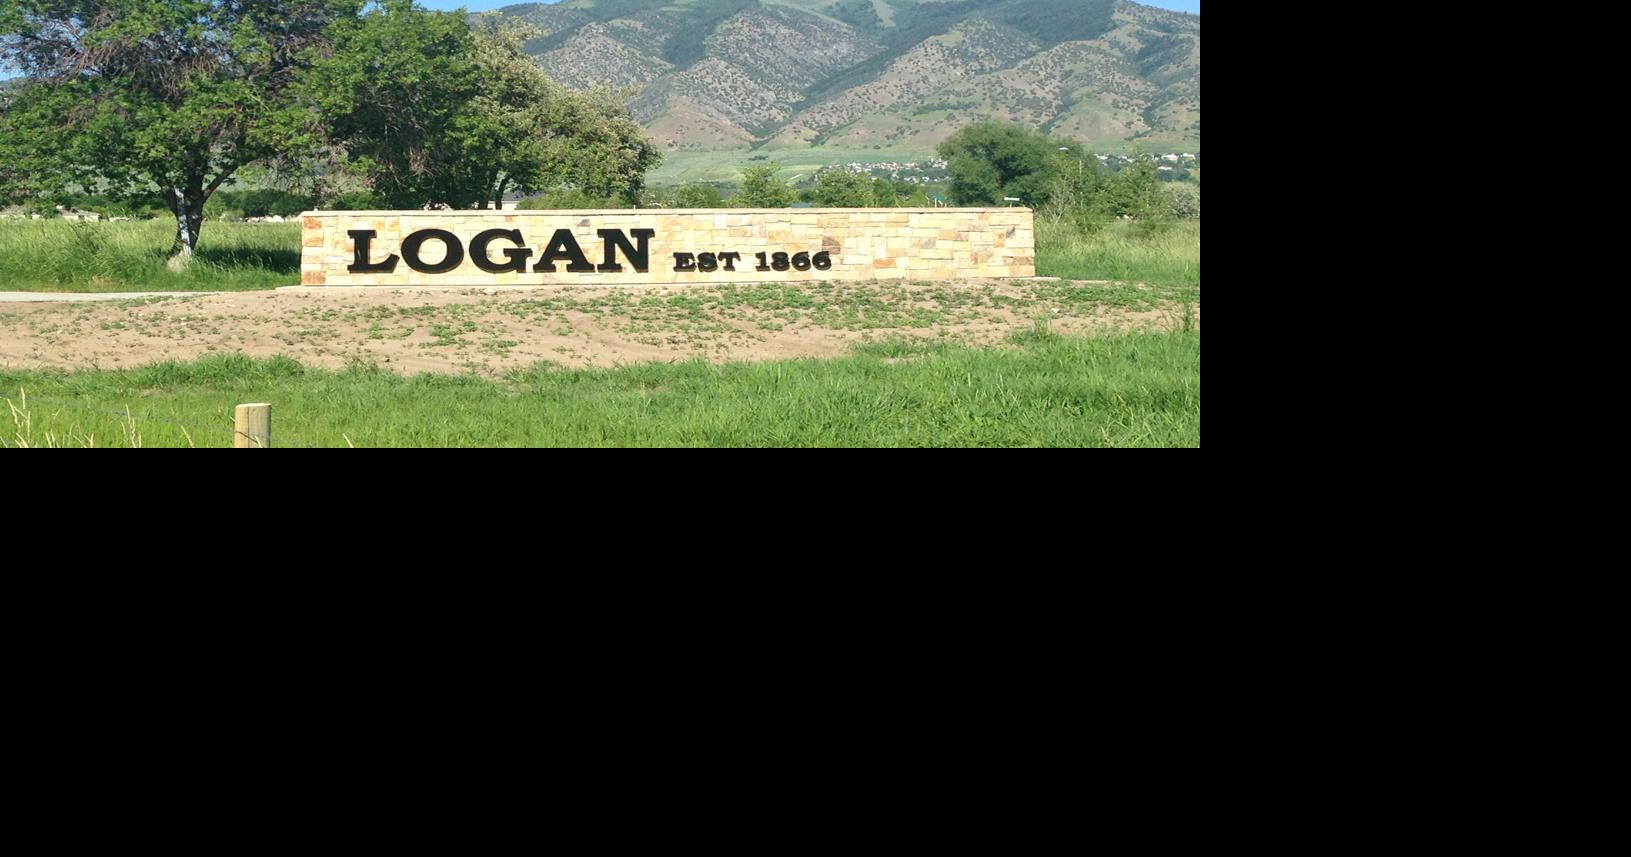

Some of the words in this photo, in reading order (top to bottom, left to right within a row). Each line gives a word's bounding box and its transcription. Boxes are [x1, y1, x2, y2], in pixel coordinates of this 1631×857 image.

[347, 228, 655, 274] LOGAN
[673, 251, 741, 272] EST
[755, 251, 832, 272] 1866
